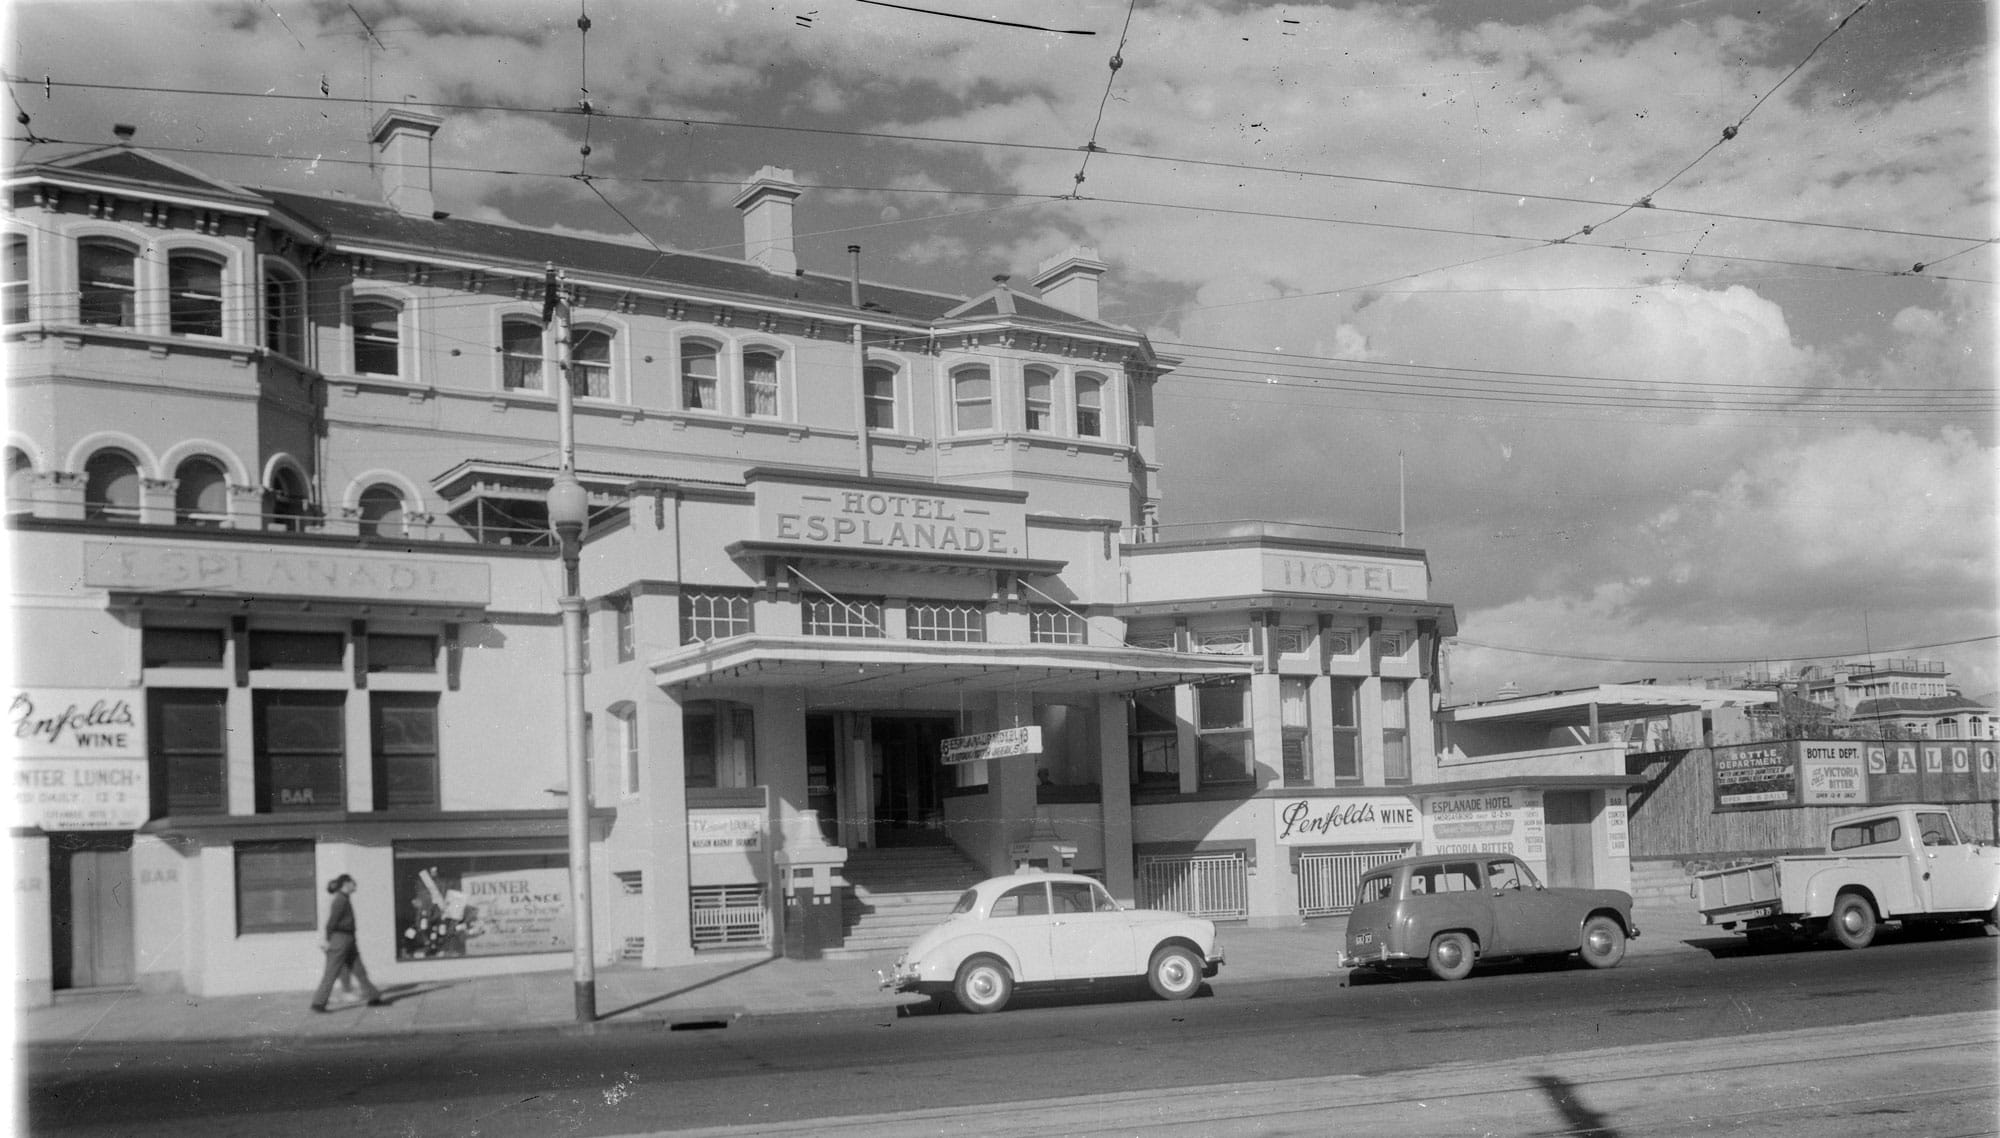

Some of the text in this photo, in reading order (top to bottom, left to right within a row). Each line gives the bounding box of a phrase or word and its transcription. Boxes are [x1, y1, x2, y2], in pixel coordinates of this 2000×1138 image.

[842, 491, 956, 521] HOTEL
[776, 513, 1019, 555] ESPLANADE.
[1282, 559, 1409, 594] HOTEL
[9, 692, 134, 743] Penfolds
[76, 733, 127, 747] WINE
[1731, 748, 1777, 760] BOTTLE
[1806, 748, 1860, 759] BOTTLE DEPT.
[1719, 756, 1783, 769] DEPARTMENT
[74, 769, 134, 786] LUNCH
[1823, 767, 1859, 778] VICTORIA
[1828, 780, 1854, 790] BITTER
[281, 788, 315, 804] BAR
[1610, 797, 1622, 806] BAR
[1432, 796, 1513, 813] ESPLANADE HOTEL
[1280, 800, 1414, 839] Penfolds WINE
[1436, 841, 1515, 855] VICTORIA BITTER
[139, 868, 179, 885] BAR
[17, 877, 42, 893] AR
[470, 880, 529, 896] DINNER
[510, 894, 561, 905] DANCE
